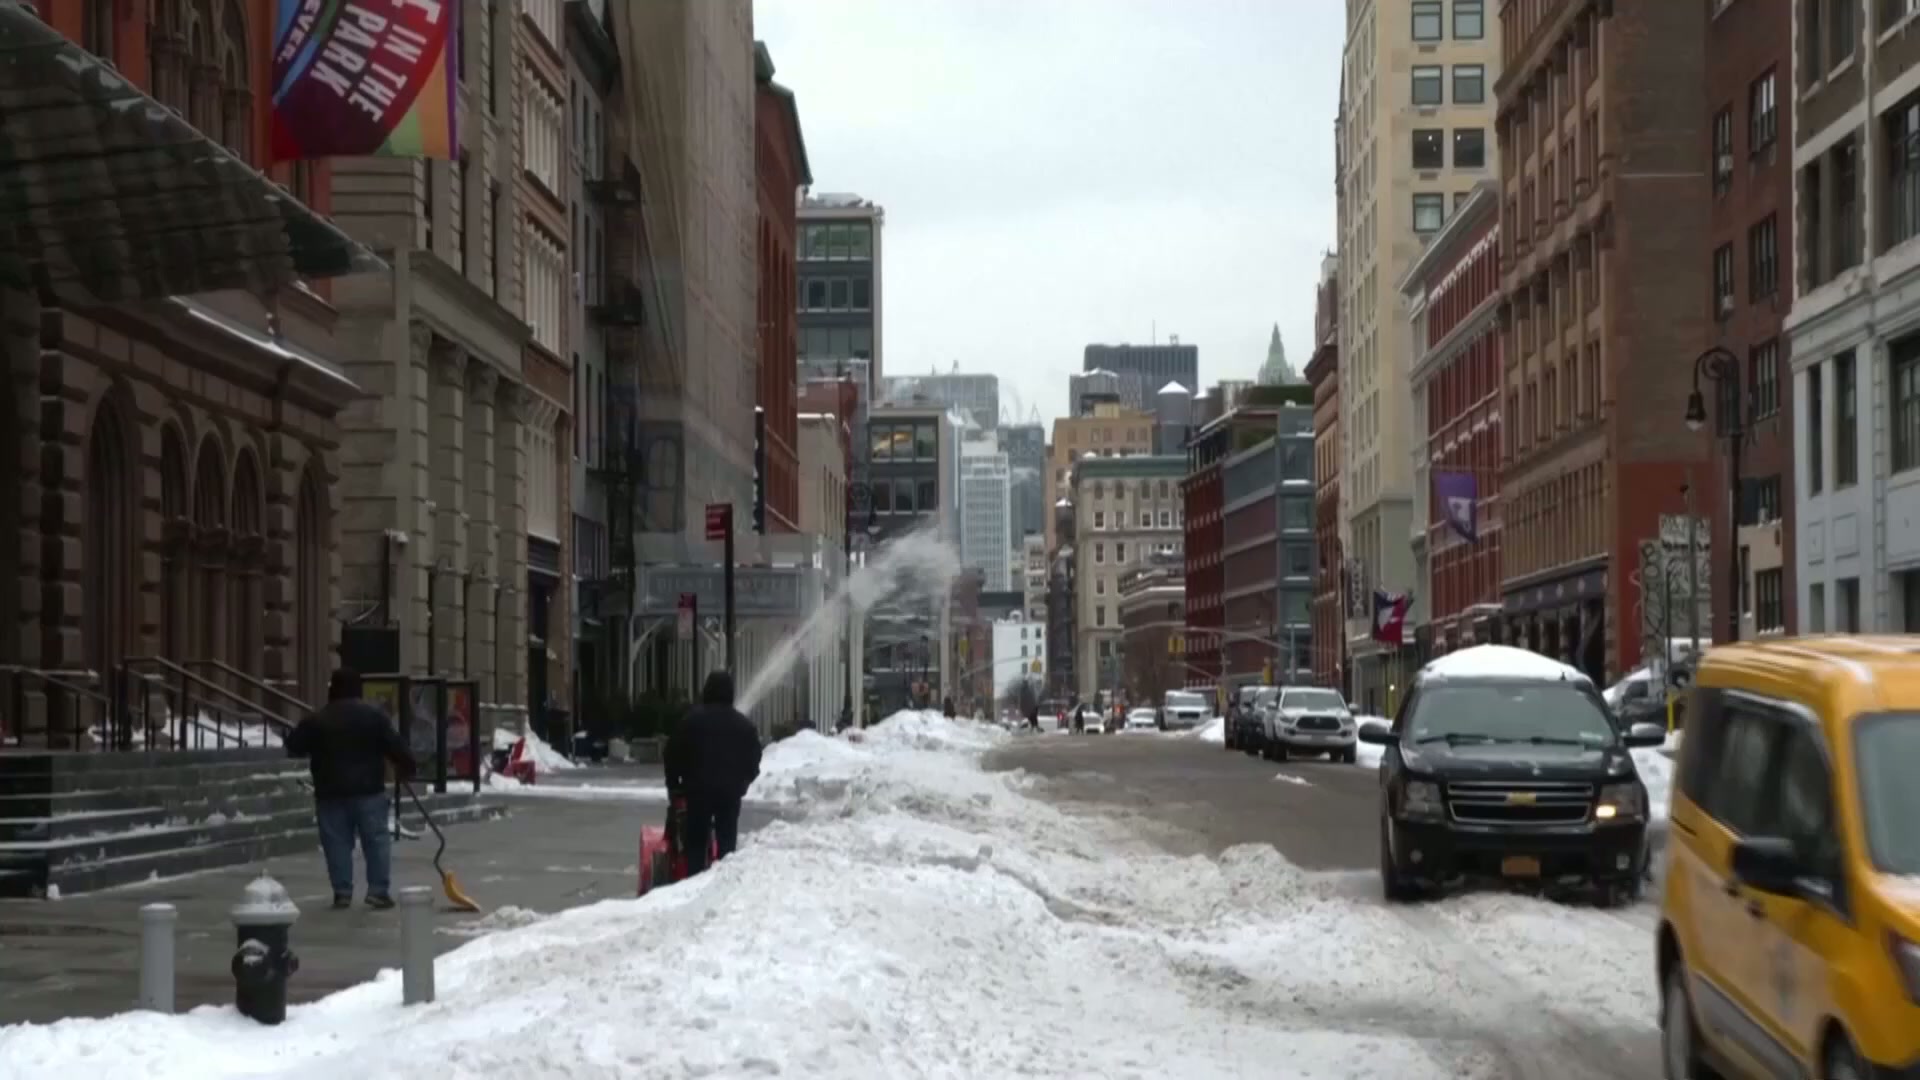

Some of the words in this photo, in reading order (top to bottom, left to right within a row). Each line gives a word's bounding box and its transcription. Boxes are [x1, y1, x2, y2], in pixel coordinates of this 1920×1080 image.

[310, 4, 387, 97] PARK
[383, 24, 427, 64] IN
[348, 63, 407, 123] THE
